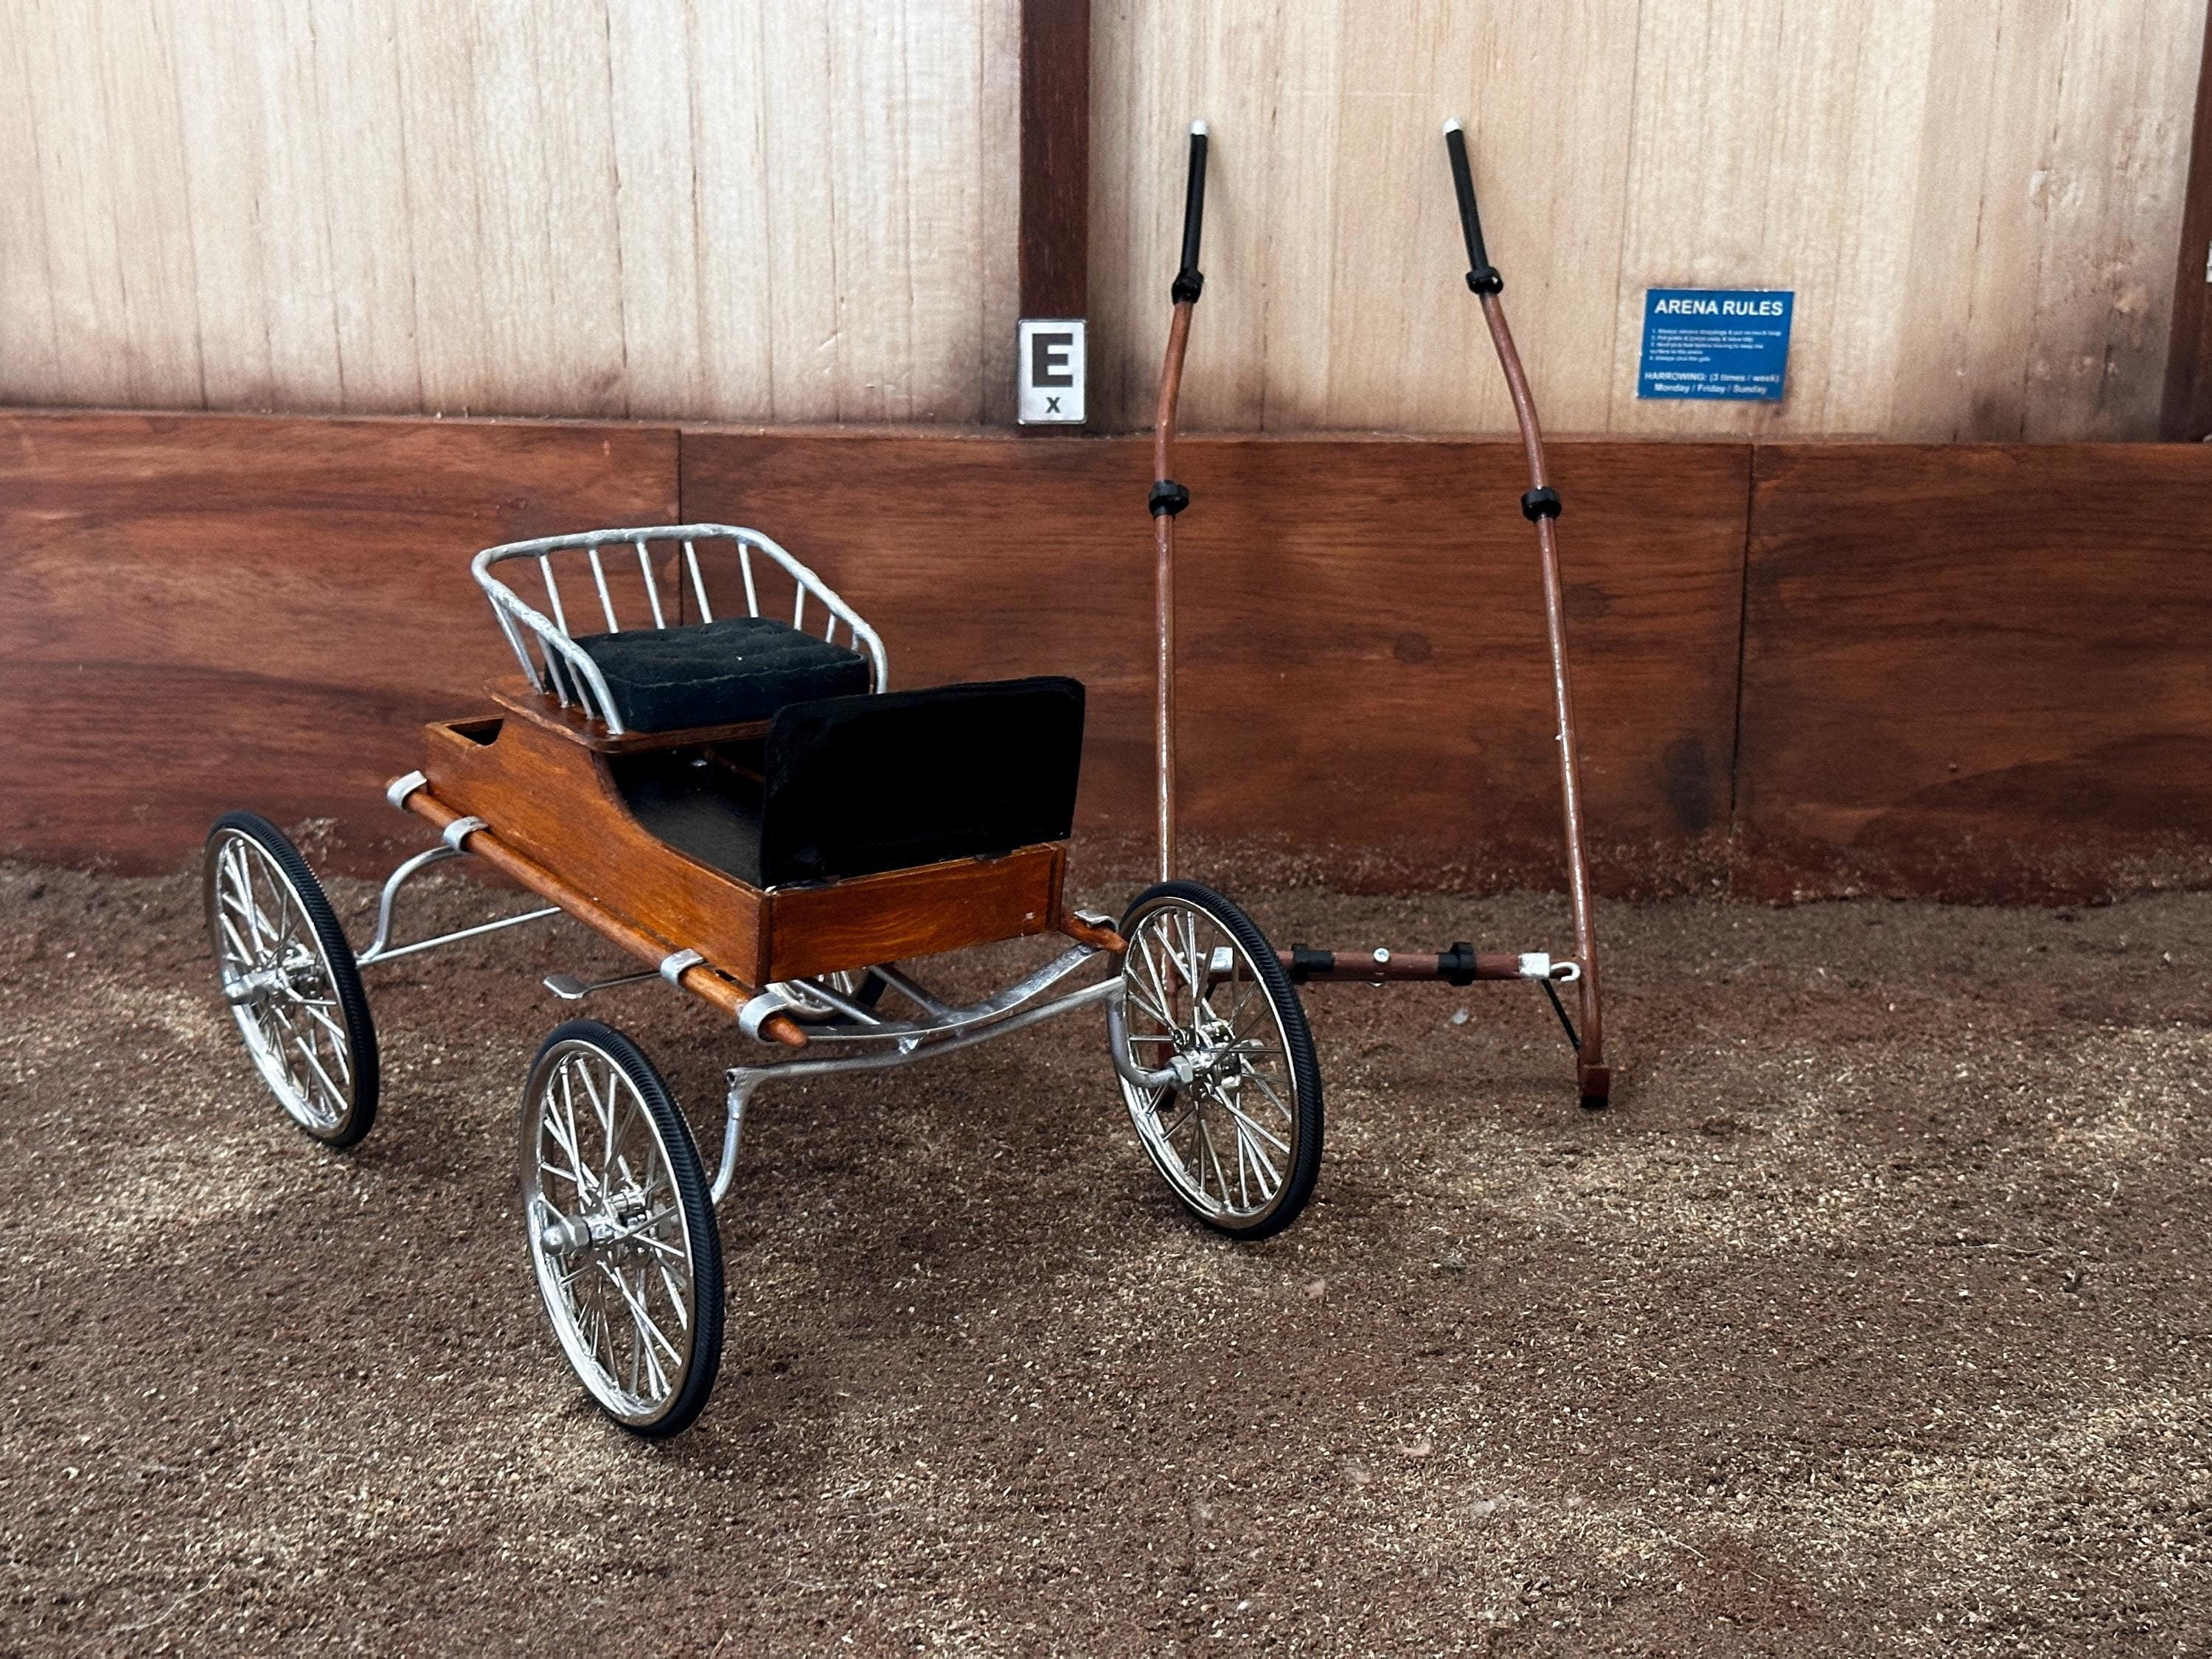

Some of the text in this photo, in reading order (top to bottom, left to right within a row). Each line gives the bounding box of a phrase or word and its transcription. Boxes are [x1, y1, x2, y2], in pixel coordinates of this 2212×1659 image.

[1655, 299, 1784, 316] ARENA RULES
[1032, 333, 1074, 388] E
[1654, 383, 1690, 394] Monday
[1697, 384, 1726, 394] Friday
[1733, 384, 1767, 395] Sunday
